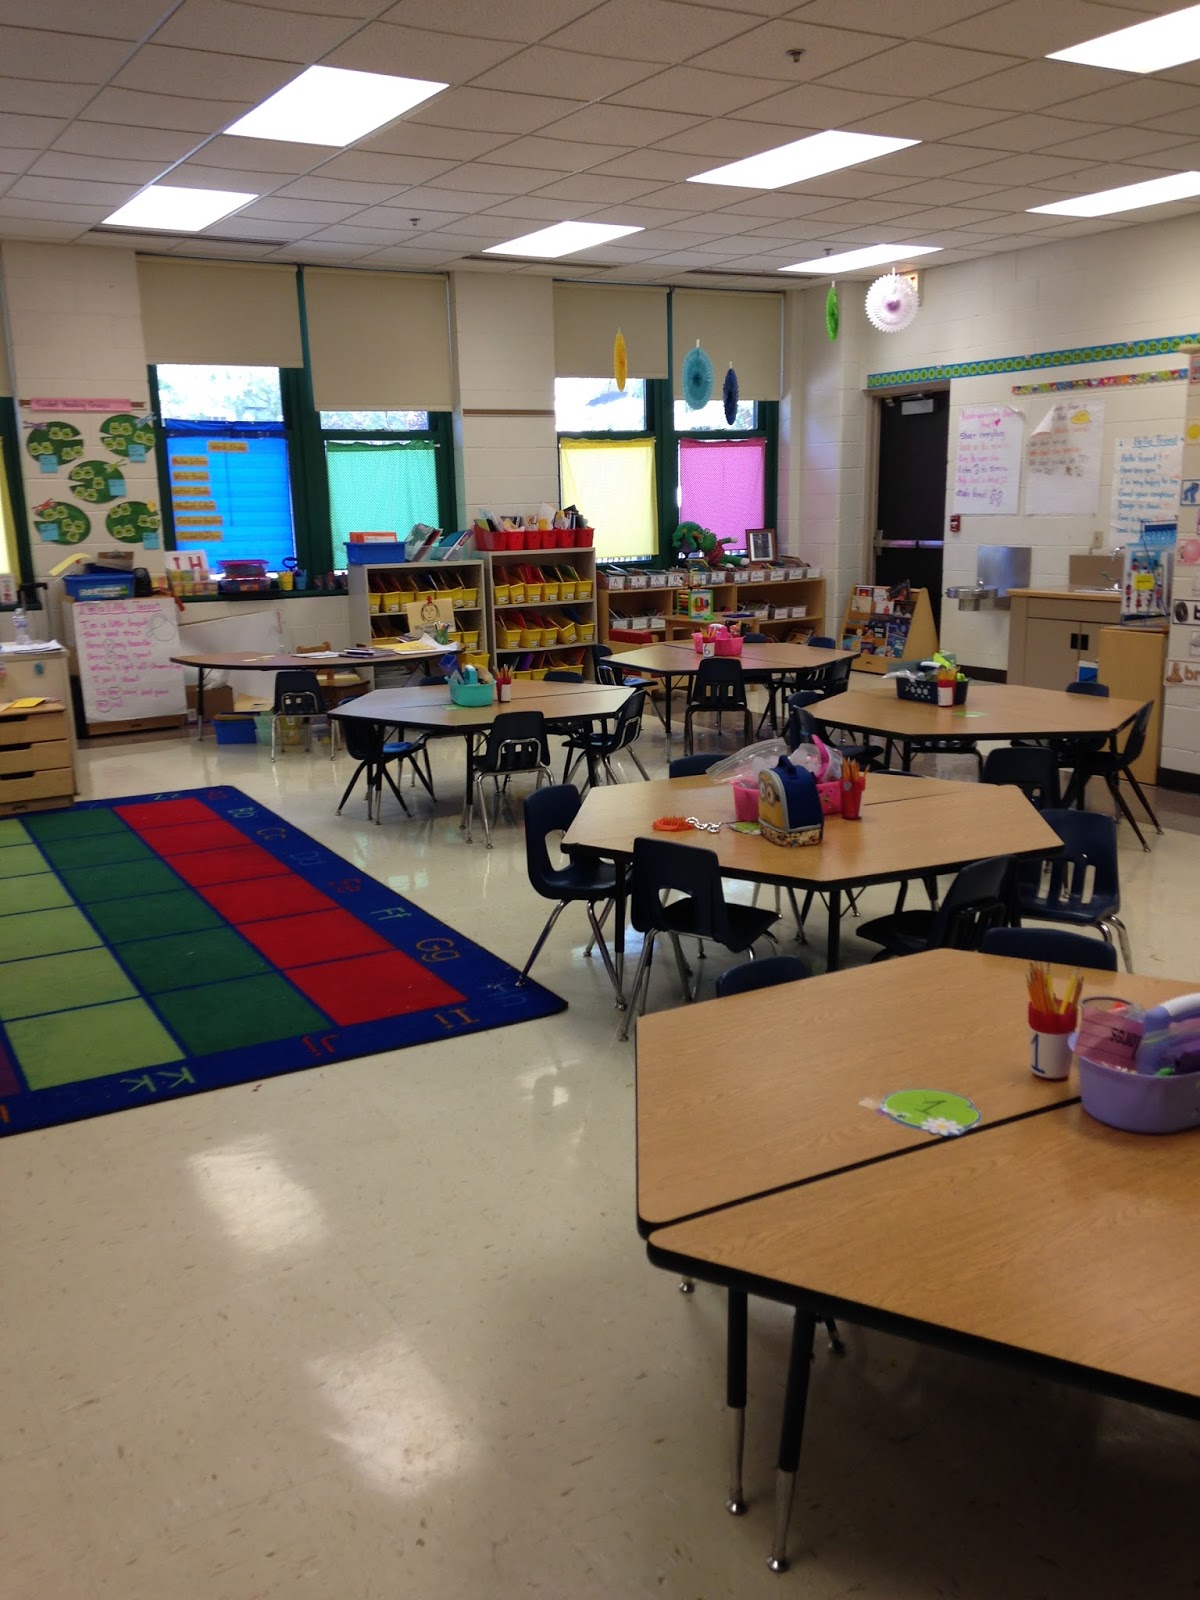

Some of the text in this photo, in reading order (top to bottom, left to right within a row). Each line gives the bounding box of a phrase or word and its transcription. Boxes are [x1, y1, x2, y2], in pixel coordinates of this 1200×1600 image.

[703, 644, 711, 656] 6
[369, 907, 412, 920] Ff
[415, 937, 461, 963] Gg
[1030, 1033, 1046, 1075] 1
